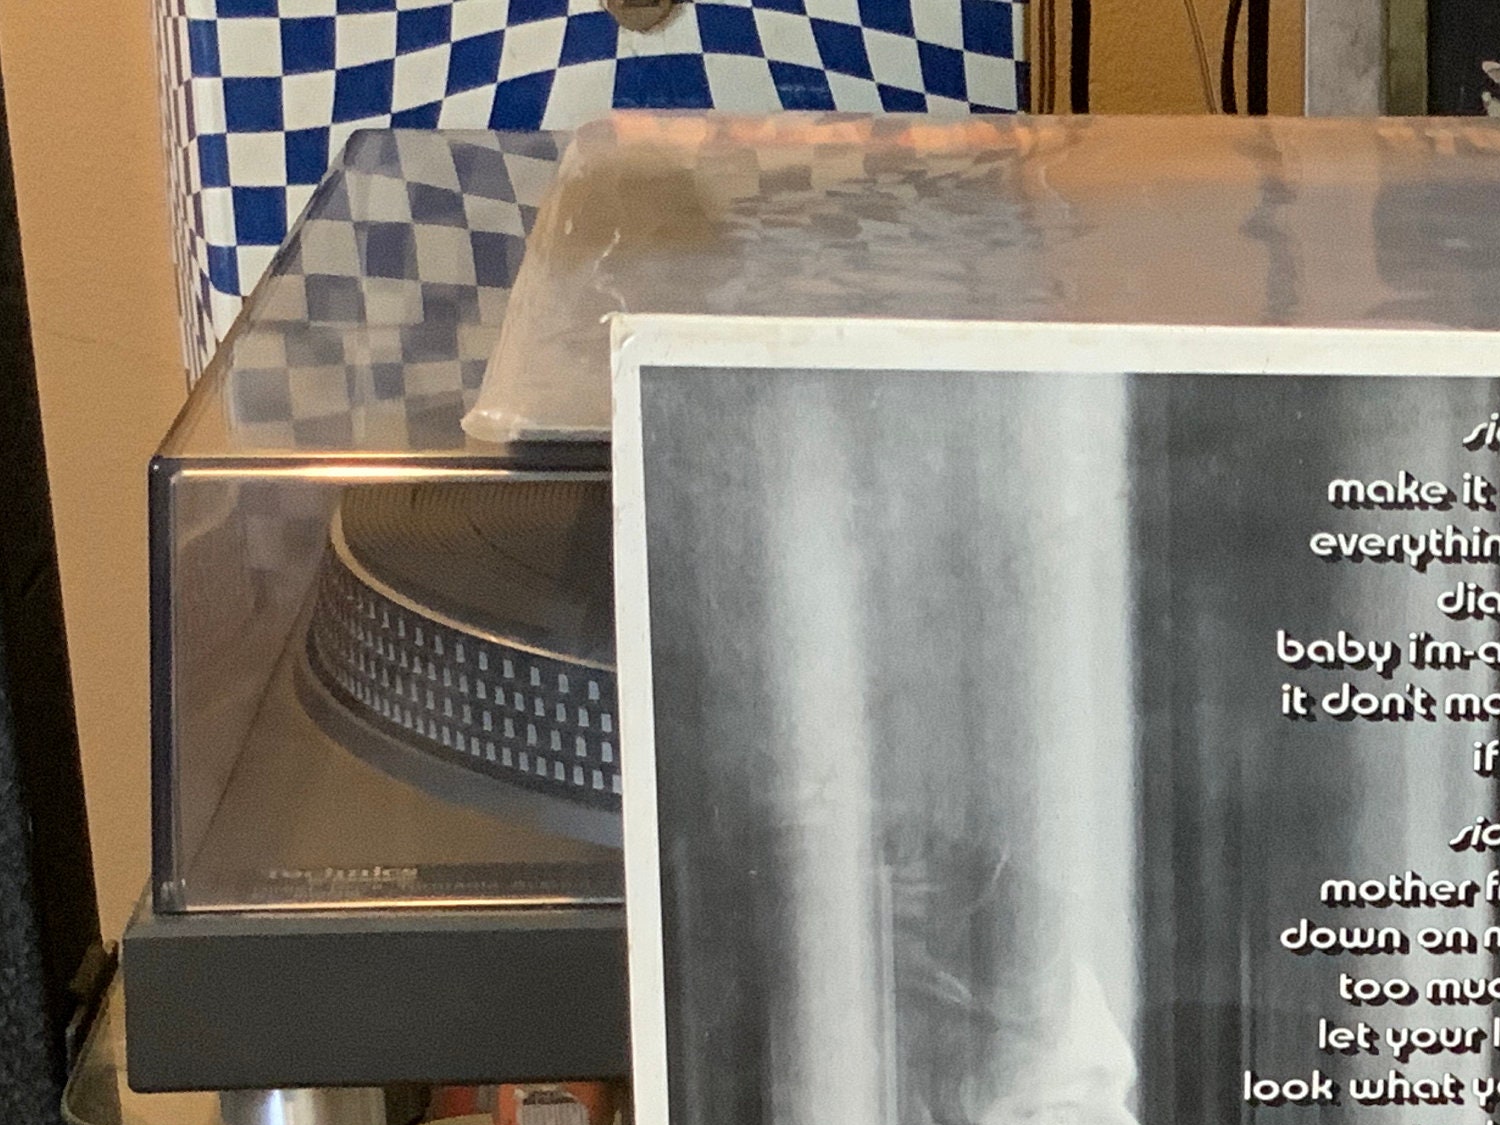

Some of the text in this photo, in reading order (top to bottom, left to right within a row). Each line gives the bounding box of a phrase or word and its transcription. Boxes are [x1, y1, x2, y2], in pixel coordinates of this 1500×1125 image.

[1327, 470, 1448, 505] make
[1462, 471, 1498, 506] it
[1276, 630, 1393, 673] baby
[1281, 683, 1308, 716] it
[1321, 683, 1428, 716] don't
[1473, 739, 1499, 772] if
[1319, 871, 1475, 902] mother
[1280, 918, 1402, 950] down
[1417, 925, 1470, 950] on
[1339, 970, 1410, 1000] too
[1318, 1018, 1373, 1050] let
[1385, 1022, 1482, 1056] your
[1243, 1070, 1334, 1101] look
[1348, 1069, 1458, 1101] what
